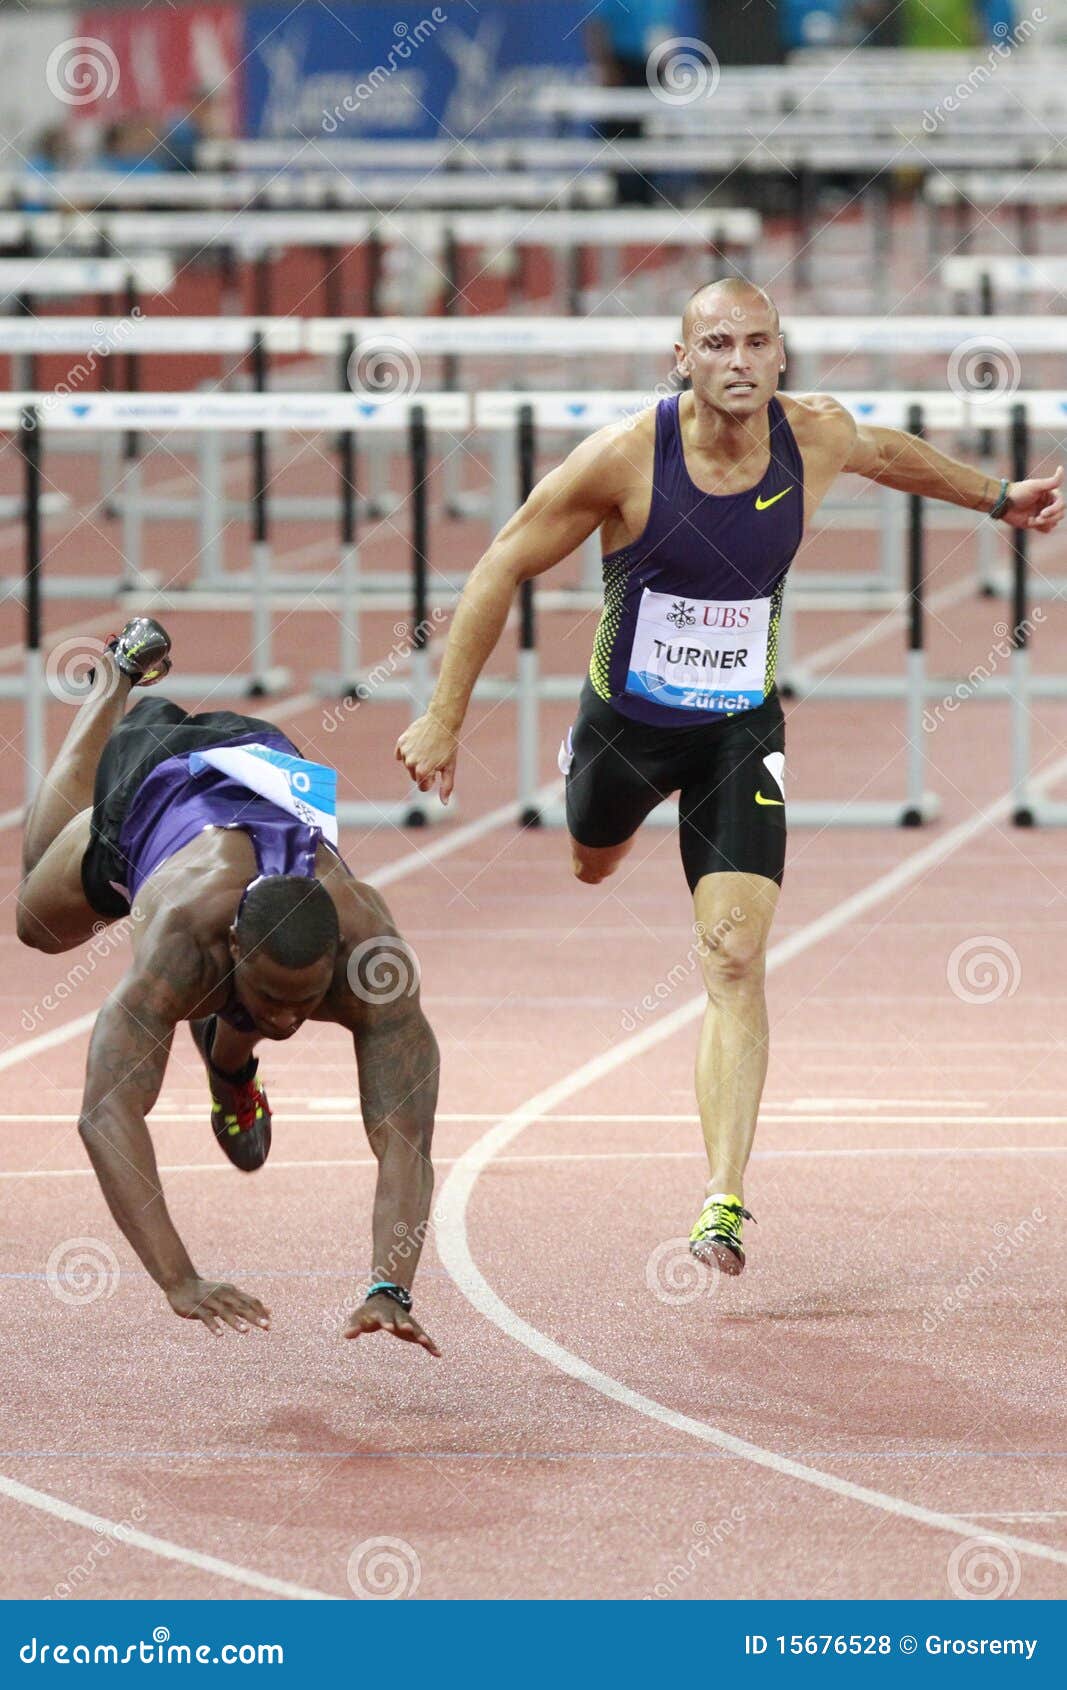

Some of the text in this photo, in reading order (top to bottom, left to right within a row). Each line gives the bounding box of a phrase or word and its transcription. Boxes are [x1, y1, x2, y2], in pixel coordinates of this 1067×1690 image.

[702, 605, 751, 629] UBS
[653, 639, 749, 670] TURNER
[680, 690, 751, 711] Zürich
